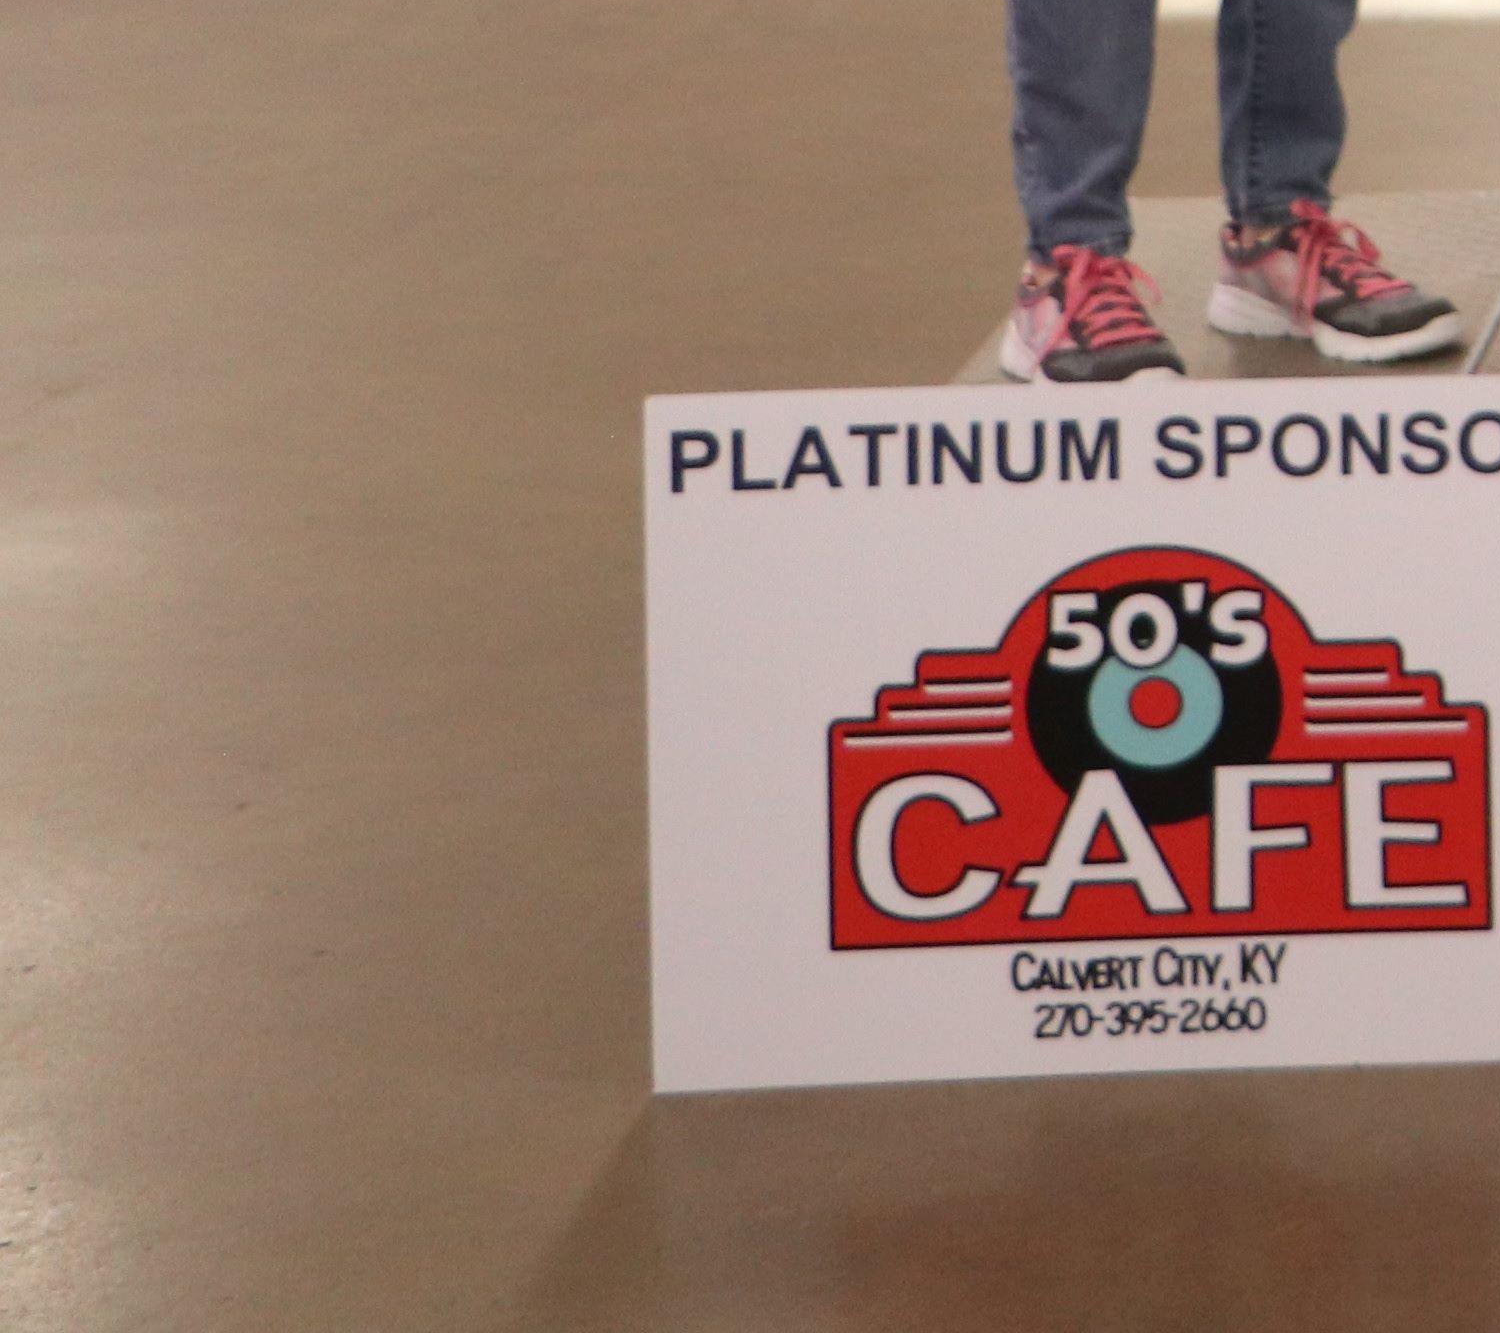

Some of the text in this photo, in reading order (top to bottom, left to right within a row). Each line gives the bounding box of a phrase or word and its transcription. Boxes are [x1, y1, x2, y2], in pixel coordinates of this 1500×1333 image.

[669, 418, 1121, 494] PLATINUM
[851, 757, 1472, 923] CAFE
[1239, 941, 1287, 985] KY
[1034, 996, 1268, 1041] 270-395-2660
